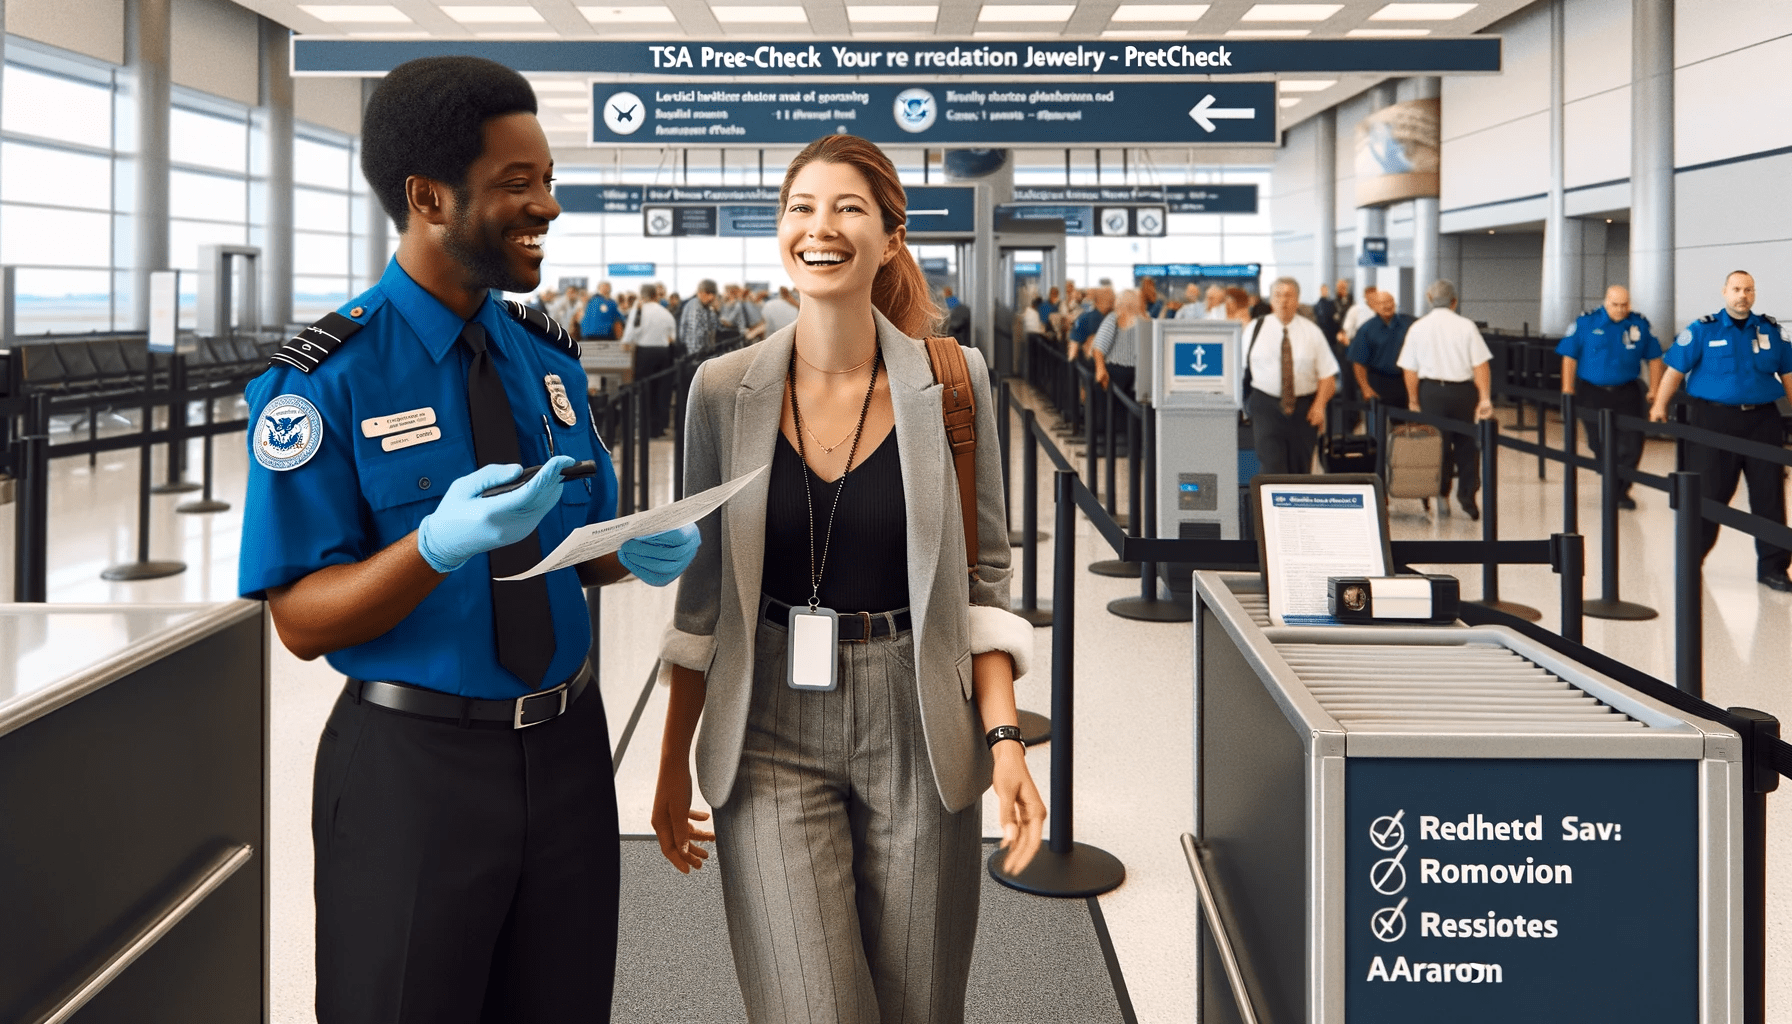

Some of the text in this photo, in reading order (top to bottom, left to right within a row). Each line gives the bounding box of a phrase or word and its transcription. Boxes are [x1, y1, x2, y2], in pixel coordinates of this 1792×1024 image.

[648, 45, 694, 68] TSA
[701, 45, 822, 69] Pree-Check
[831, 45, 883, 69] Your
[914, 46, 1018, 68] rredation
[1023, 44, 1106, 72] Jewelry
[1124, 44, 1233, 68] PretCheck
[1419, 813, 1622, 842] Redhetd Sav:
[1420, 856, 1573, 884] Romovion
[1420, 910, 1559, 938] Ressiotes
